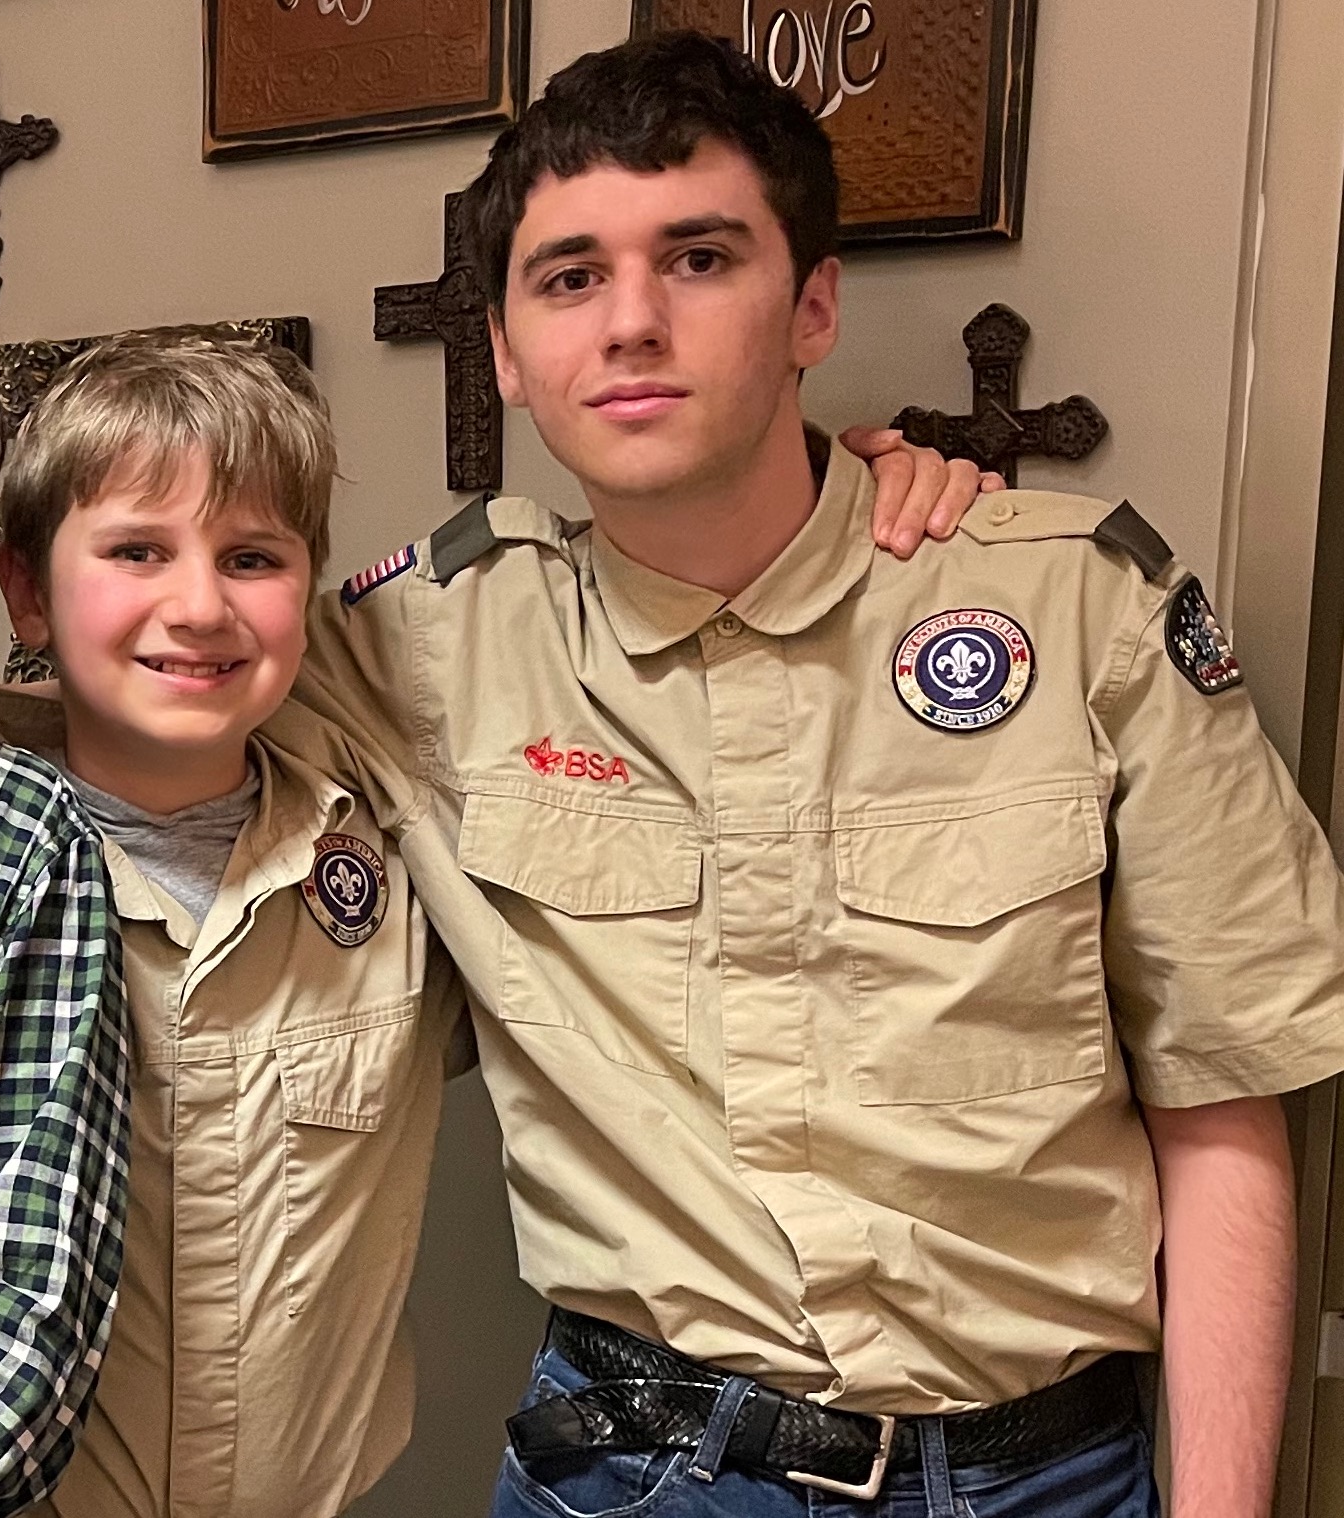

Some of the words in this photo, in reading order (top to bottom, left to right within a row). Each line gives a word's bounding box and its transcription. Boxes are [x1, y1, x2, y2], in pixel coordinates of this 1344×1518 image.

[972, 613, 1024, 654] AMERICA
[933, 709, 976, 726] SINCE
[975, 702, 1004, 723] 1910
[564, 749, 630, 784] BSA
